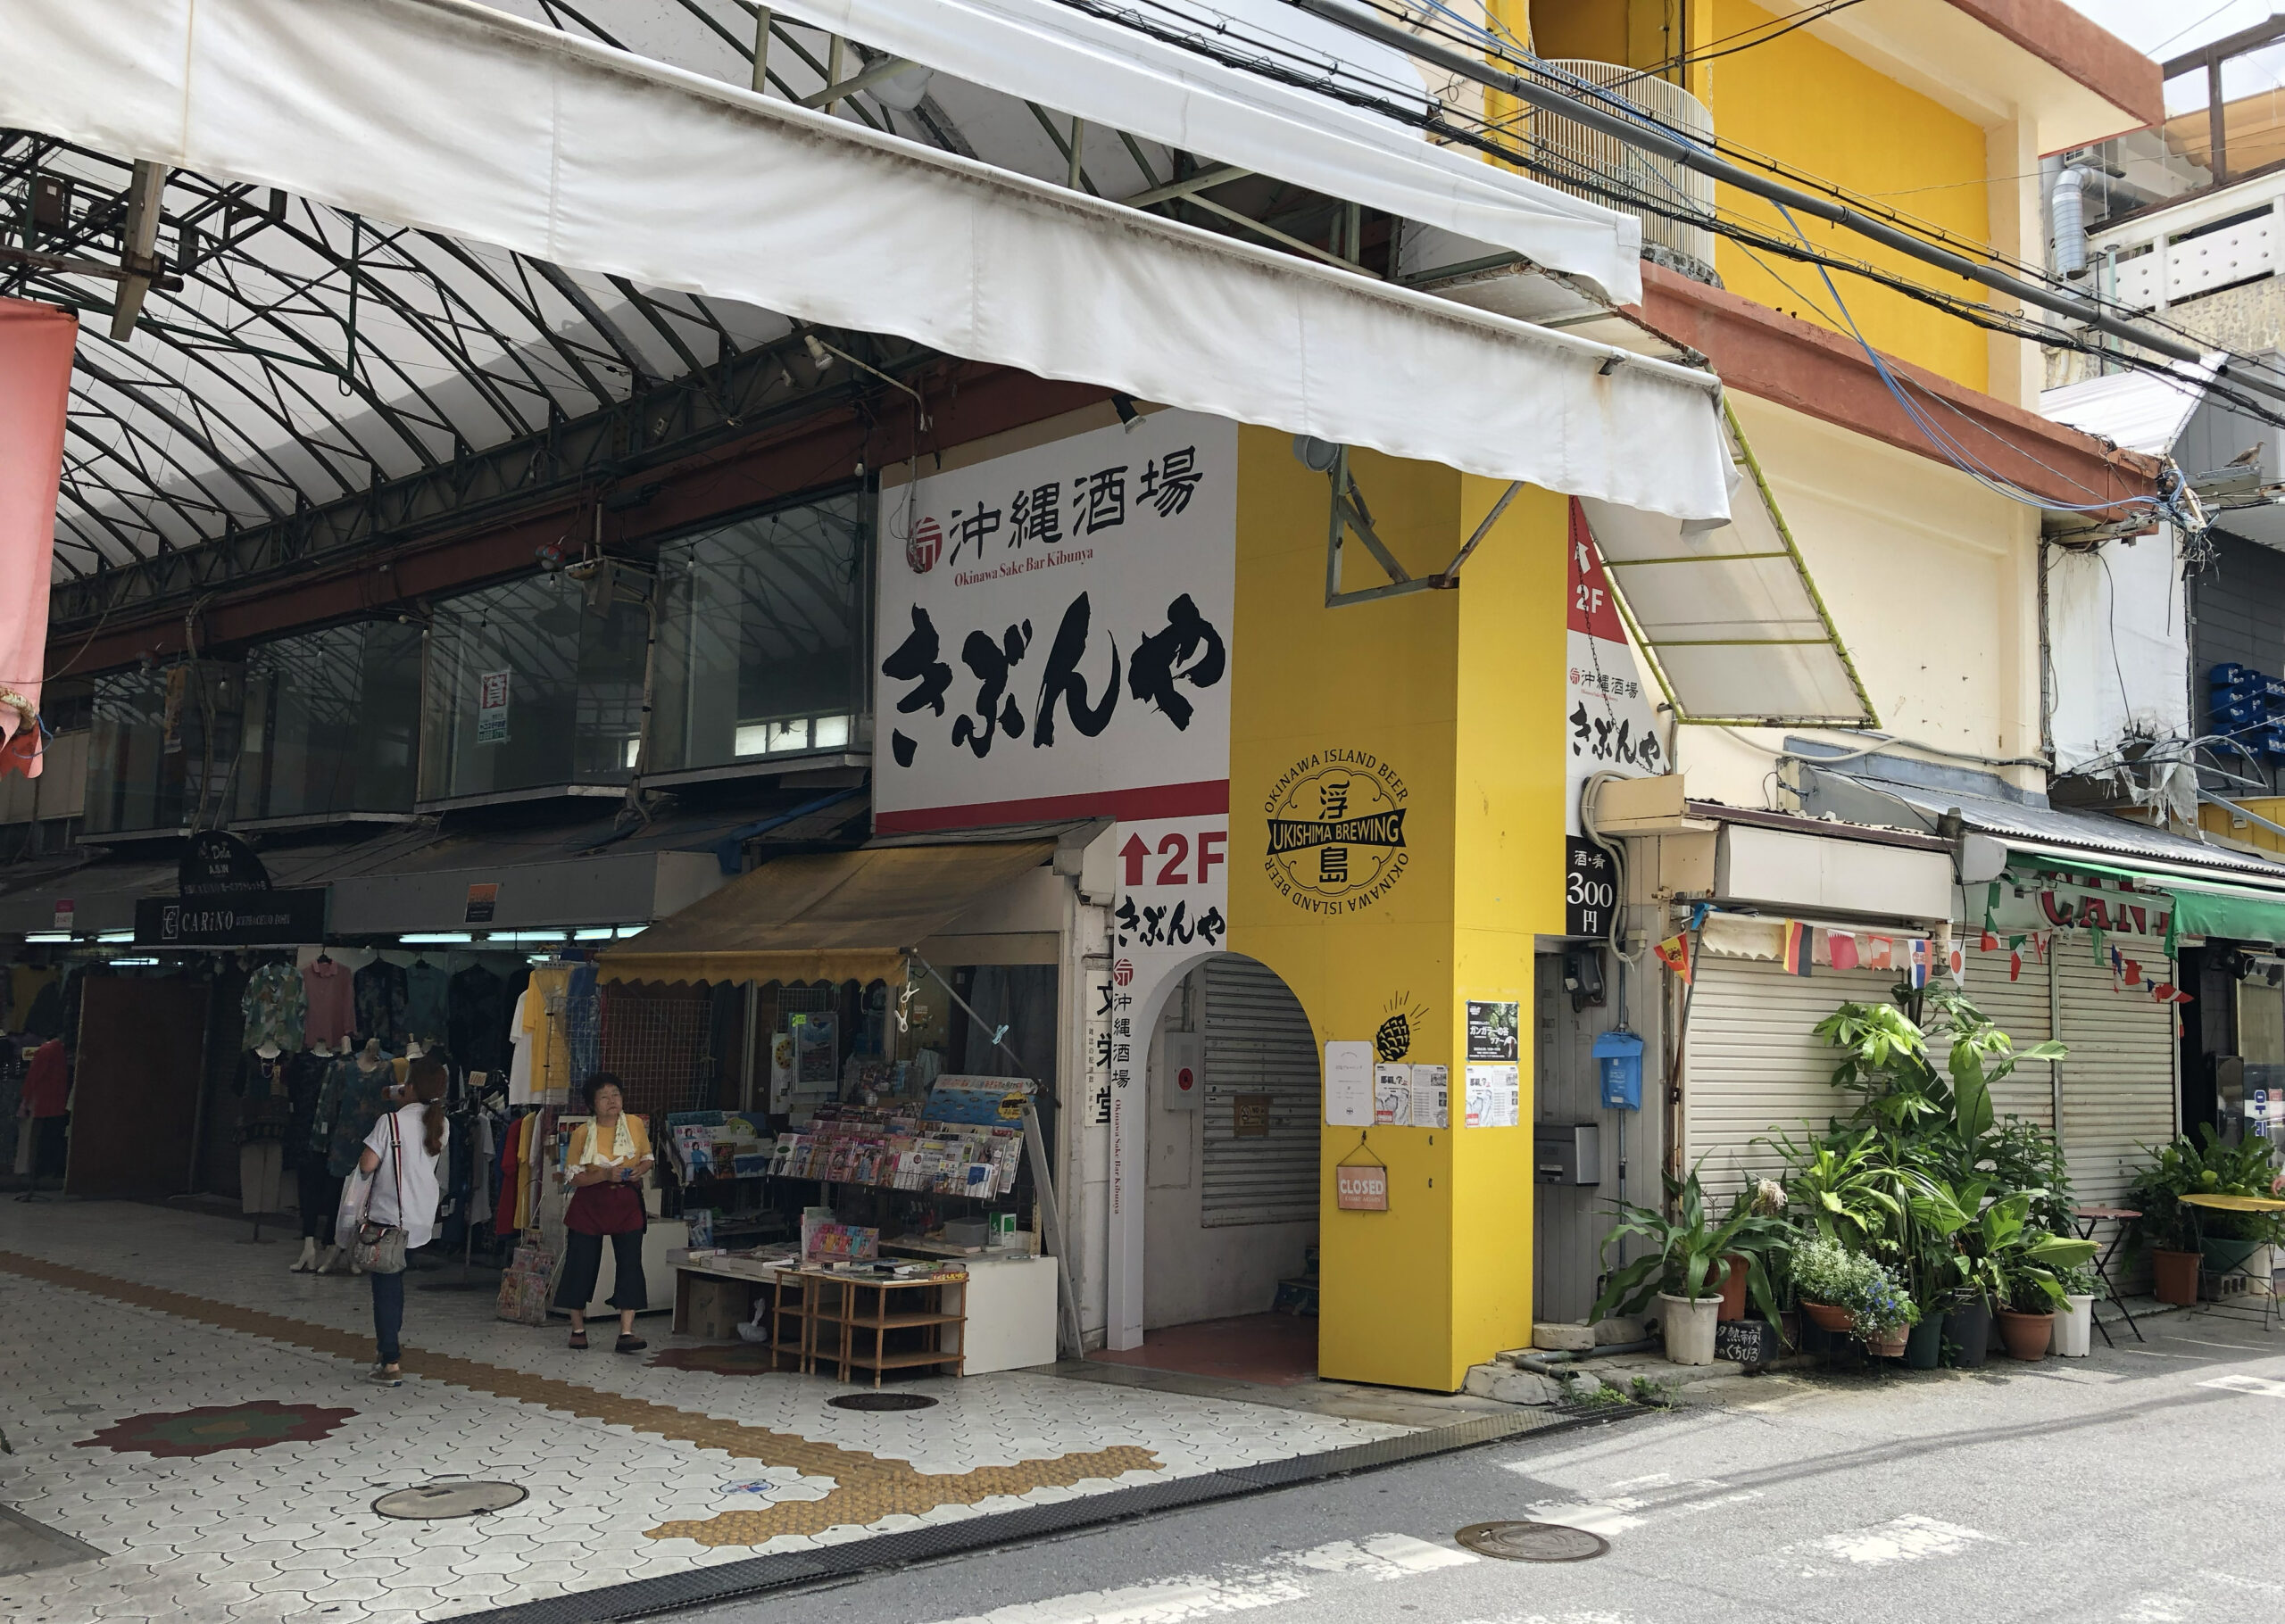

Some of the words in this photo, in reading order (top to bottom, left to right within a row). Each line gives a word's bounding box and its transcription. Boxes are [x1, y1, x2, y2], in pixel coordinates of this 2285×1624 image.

[949, 445, 1203, 567] 沖縄酒場
[954, 569, 998, 587] Okinawa
[1000, 560, 1025, 578] Sake
[1026, 557, 1045, 572] Bar
[1047, 548, 1093, 568] Kibunya
[1575, 584, 1604, 614] 2F
[882, 591, 1226, 768] きぶんや
[1581, 669, 1639, 699] 沖縄酒場
[1569, 700, 1660, 770] きぶんや
[1265, 754, 1320, 814] OKINAWA
[1324, 749, 1376, 768] ISLAND
[1377, 763, 1408, 802] BEER
[1273, 823, 1333, 850] UKISHIMA
[1335, 814, 1400, 843] BREWING
[1156, 831, 1228, 886] 2F
[1264, 858, 1292, 897] BEER
[1348, 852, 1409, 912] OKINAWA
[1566, 872, 1613, 909] 300
[1115, 894, 1226, 948] きぶんや
[1292, 891, 1342, 915] ISLAND
[1583, 909, 1598, 934] 円
[1111, 992, 1132, 1089] 沖縄酒場
[1340, 1179, 1384, 1195] CLOSED
[1726, 1344, 1758, 1362] くちびる
